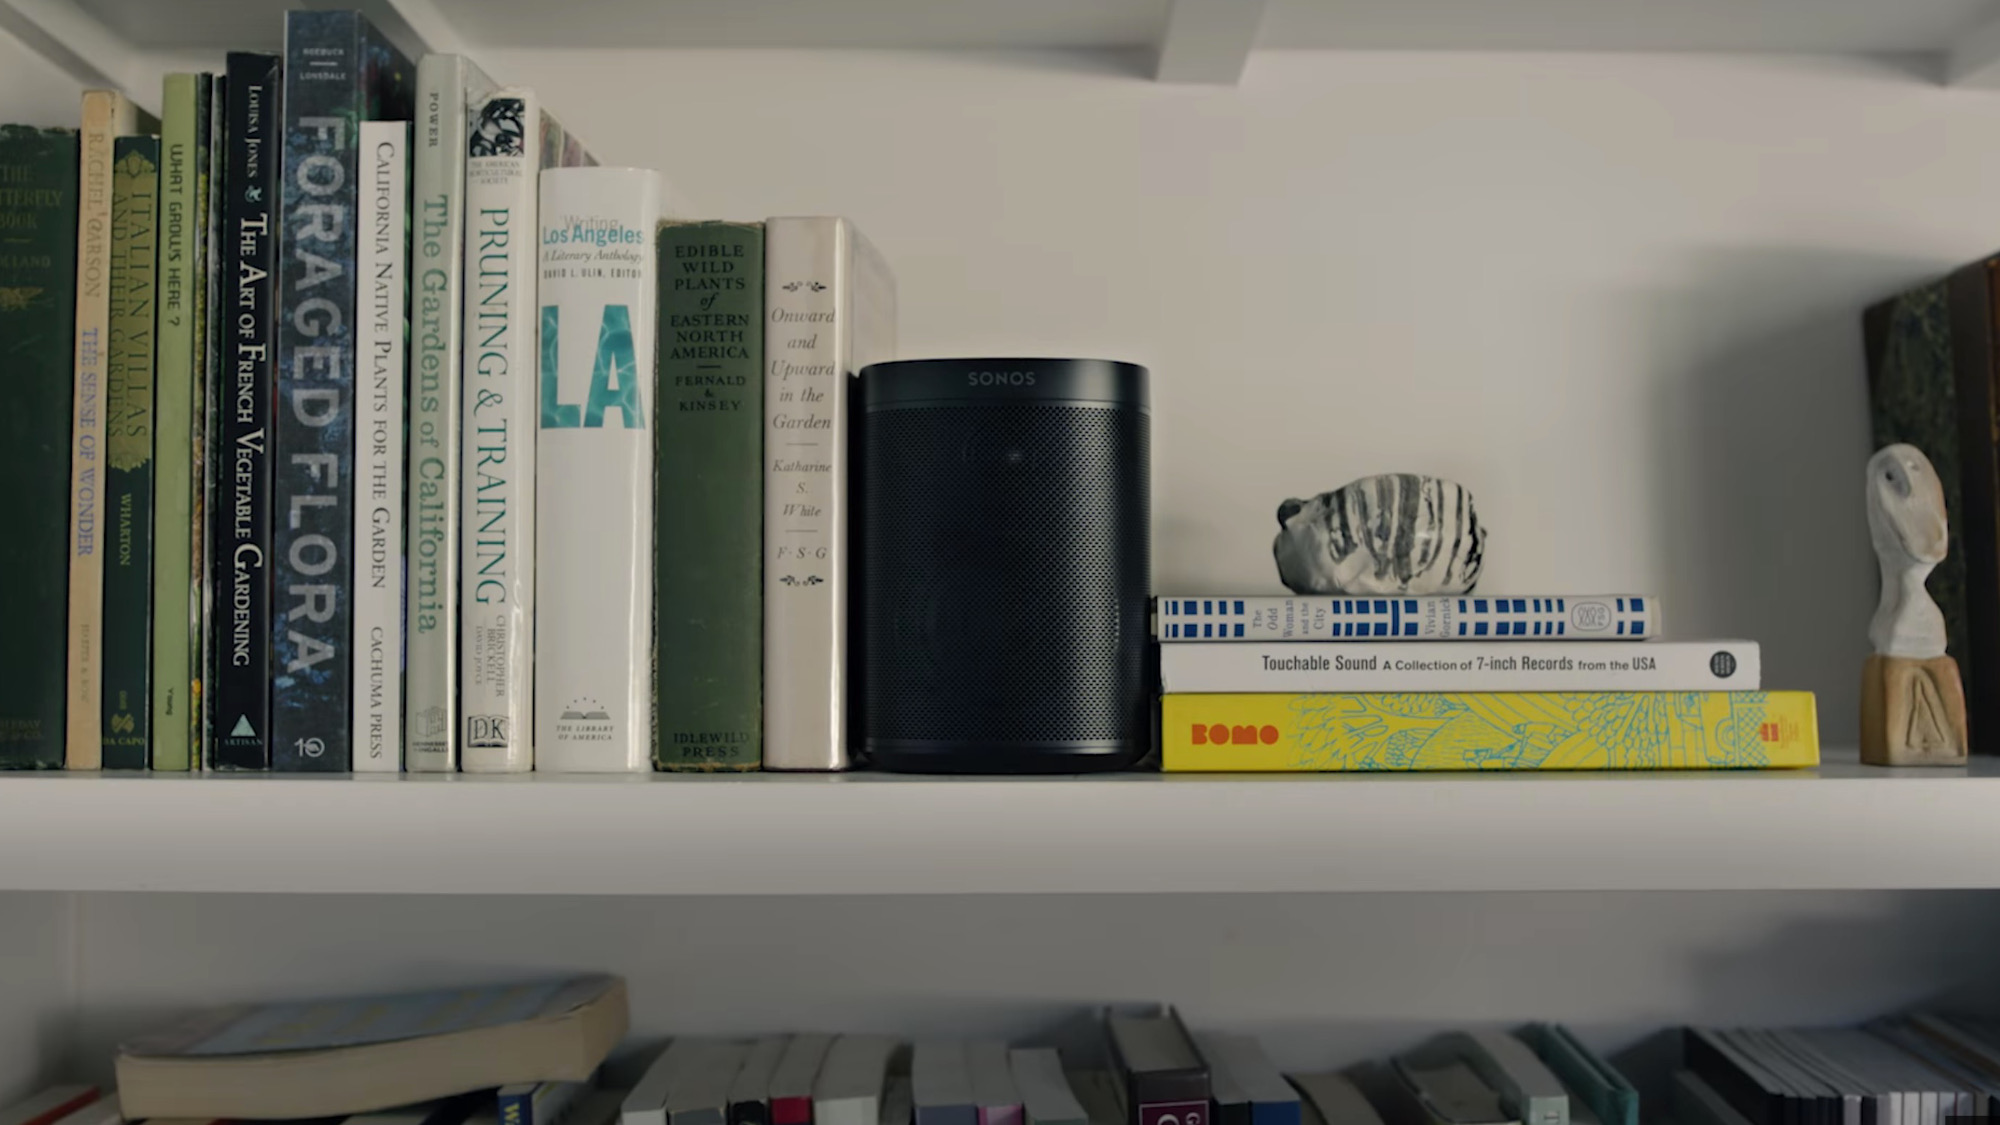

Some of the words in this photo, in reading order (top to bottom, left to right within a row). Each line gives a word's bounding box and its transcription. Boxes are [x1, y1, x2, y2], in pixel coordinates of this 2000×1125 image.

[248, 85, 263, 136] LOUISA
[428, 92, 439, 148] POWER
[87, 133, 104, 211] RACHEL
[170, 144, 183, 194] WHAT
[246, 138, 261, 178] JONES
[112, 193, 129, 241] AND
[374, 142, 395, 255] CALIFORNIA
[168, 202, 182, 264] GROWS
[240, 212, 268, 256] THE
[423, 194, 448, 258] The
[543, 226, 569, 244] Los
[572, 225, 643, 247] Angeles
[563, 215, 619, 232] Writing
[85, 219, 103, 298] CARSON
[129, 191, 152, 319] ITALIAN
[291, 116, 346, 426] FORAGED
[551, 250, 592, 263] Literary
[675, 245, 744, 258] EDIBLE
[682, 261, 734, 273] WILD
[111, 253, 128, 318] THEIR
[167, 269, 181, 309] HERE
[239, 261, 267, 308] ART
[373, 262, 393, 335] NATIVE
[478, 208, 510, 377] PRUNING
[674, 277, 745, 290] PLANTS
[700, 292, 719, 311] of
[238, 312, 253, 339] OF
[670, 314, 749, 327] EASTERN
[771, 307, 835, 323] Onward
[81, 328, 99, 367] THE
[421, 268, 448, 412] Gardens
[670, 346, 749, 359] AMERICA
[676, 330, 743, 343] NORTH
[787, 334, 817, 349] and
[107, 329, 126, 438] GARDENS
[126, 331, 148, 438] VILLAS
[236, 344, 266, 423] FRENCH
[372, 342, 392, 412] PLANTS
[541, 304, 646, 429] LA
[675, 375, 746, 387] FERNALD
[771, 360, 835, 381] Upward
[968, 371, 1036, 386] SONOS
[78, 372, 97, 428] SENSE
[473, 388, 508, 416] &
[679, 400, 741, 412] KINSEY
[704, 388, 714, 398] &
[779, 388, 793, 402] in
[801, 386, 824, 402] the
[373, 419, 388, 456] FOR
[419, 422, 440, 447] of
[773, 414, 832, 429] Garden
[79, 435, 96, 461] OF
[772, 460, 831, 473] Katharine
[234, 428, 264, 539] VEGETABLE
[372, 463, 387, 500] THE
[77, 467, 95, 556] WONDER
[120, 492, 132, 567] WHARTON
[475, 418, 508, 604] TRAINING
[783, 504, 821, 518] White
[286, 454, 339, 672] FLORA
[371, 507, 390, 589] GARDEN
[418, 457, 446, 634] California
[233, 544, 263, 666] GARDENING
[1253, 609, 1262, 628] The
[1268, 607, 1279, 631] Odd
[1283, 599, 1294, 638] Woman
[1313, 606, 1327, 630] City
[1425, 600, 1435, 636] Vivian
[1439, 597, 1450, 639] Gornick
[370, 627, 384, 709] CACHUMA
[495, 615, 507, 698] CHRISTOPHER
[1262, 655, 1330, 671] Touchable
[1336, 655, 1377, 671] Sound
[1383, 660, 1392, 671] A
[1395, 659, 1457, 671] Collection
[1460, 659, 1473, 671] of
[1476, 656, 1517, 671] 7-inch
[1522, 656, 1573, 671] Records
[1578, 660, 1606, 671] from
[1609, 660, 1629, 671] the
[1632, 657, 1656, 671] USA
[118, 737, 145, 746] CAPO
[369, 715, 383, 759] PRESS
[473, 717, 506, 741] DK
[673, 732, 750, 744] IDLEWILD
[1191, 724, 1279, 745] BOMO
[683, 746, 740, 758] PRESS
